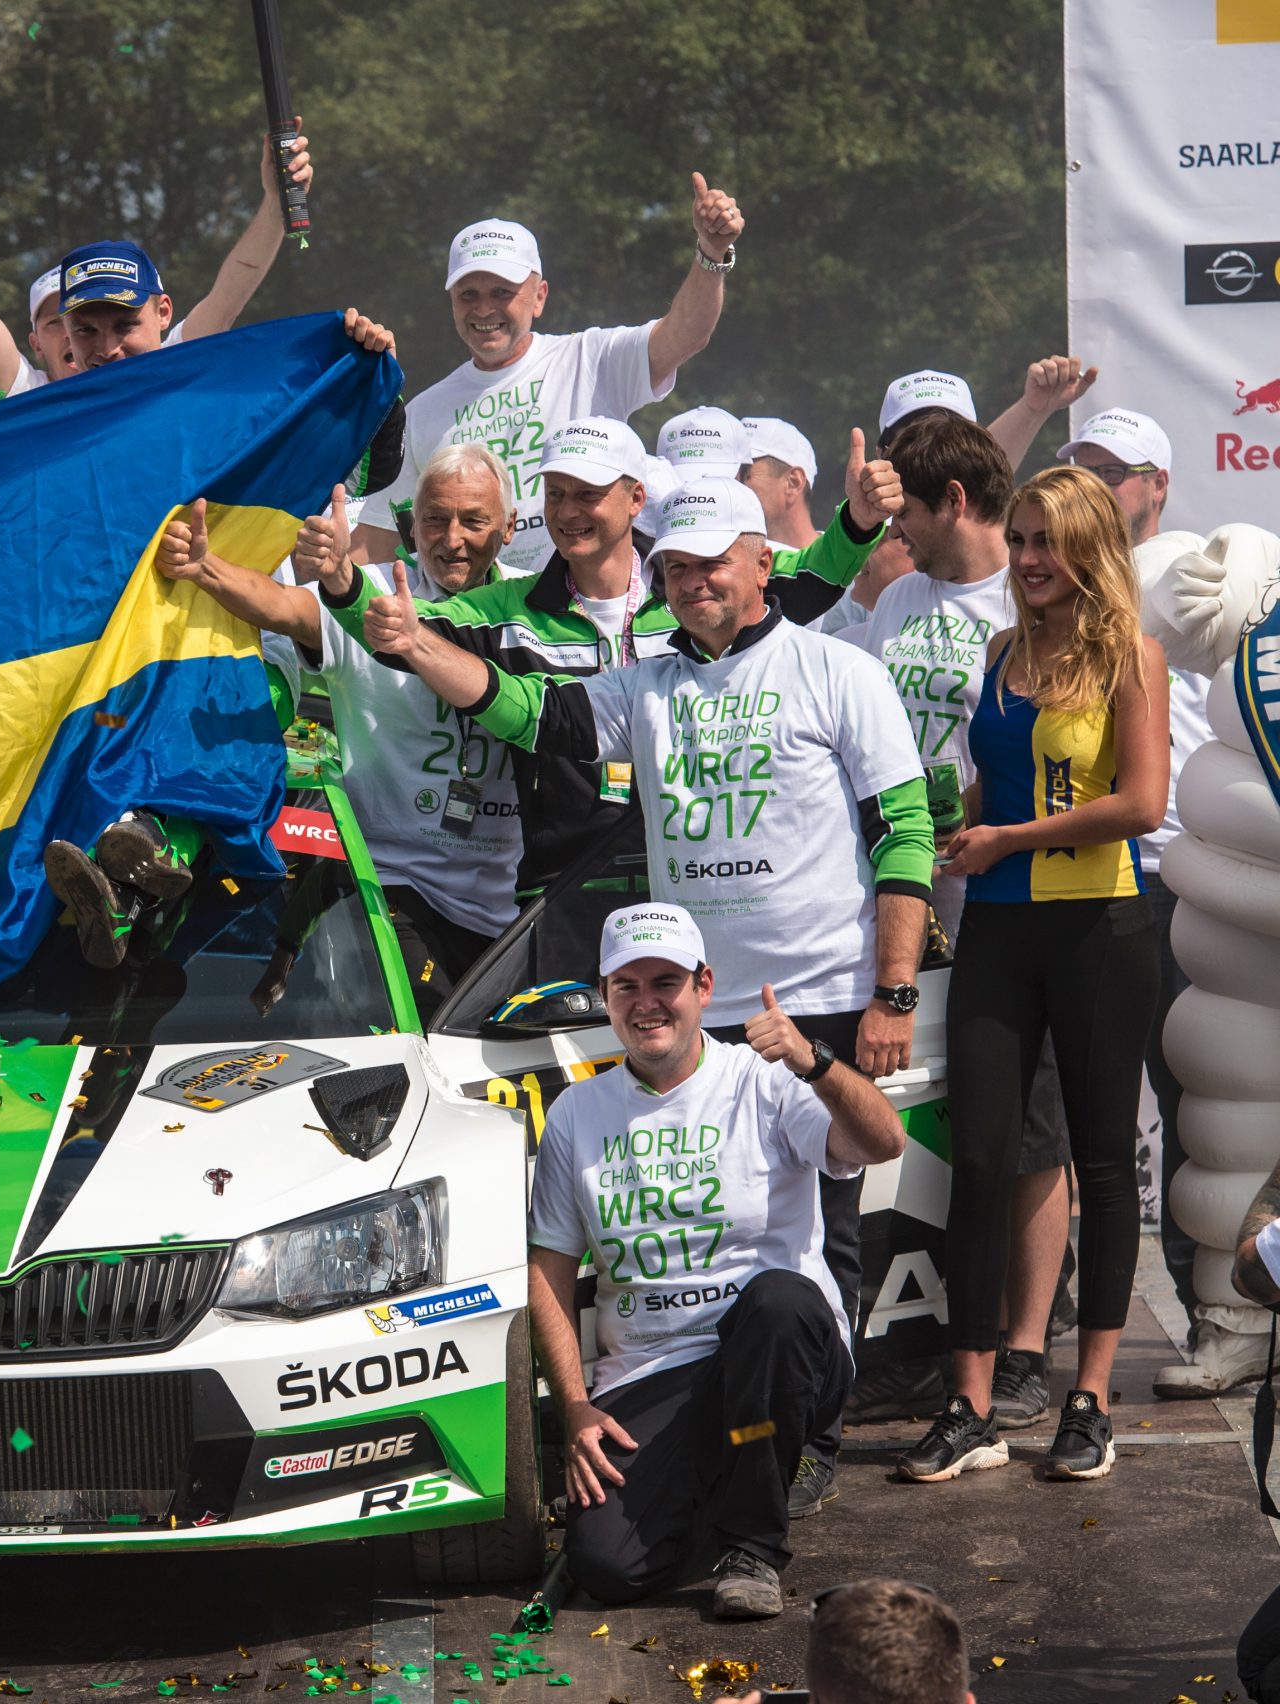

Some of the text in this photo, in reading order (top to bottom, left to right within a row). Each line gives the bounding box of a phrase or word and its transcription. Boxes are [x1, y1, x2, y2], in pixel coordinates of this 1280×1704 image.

[473, 231, 514, 242] ŠKODA
[472, 249, 498, 258] WRC2
[86, 261, 137, 275] MICHELIN
[913, 376, 956, 388] ŠKODA
[915, 391, 942, 399] WRC2
[1100, 414, 1139, 428] ŠKODA
[486, 421, 545, 462] RC2
[566, 427, 609, 440] ŠKODA
[680, 429, 721, 438] ŠKODA
[560, 446, 587, 455] WRC2
[679, 448, 704, 458] WRC2
[1216, 433, 1280, 471] Re
[673, 495, 716, 507] ŠKODA
[670, 518, 696, 529] WRC2
[900, 615, 991, 645] WORLD
[884, 642, 978, 667] CHAMPIONS
[672, 690, 781, 724] WORLD
[664, 743, 772, 788] WRC2
[476, 801, 521, 818] KODA
[283, 822, 339, 842] WRC
[685, 859, 774, 879] ŠKODA
[731, 895, 768, 906] publication
[631, 912, 679, 924] ŠKODA
[614, 926, 681, 940] WORLD CHAMPIONS
[632, 933, 662, 942] WRC2
[603, 1125, 720, 1164] WORLD
[599, 1154, 716, 1188] CHAMPIONS
[598, 1176, 726, 1230] WRC2
[412, 1289, 495, 1318] MICHELIN
[645, 1282, 741, 1312] ŠKODA
[276, 1340, 471, 1412] ŠKODA
[281, 1432, 419, 1475] Castrol EDGE
[357, 1475, 453, 1519] R5
